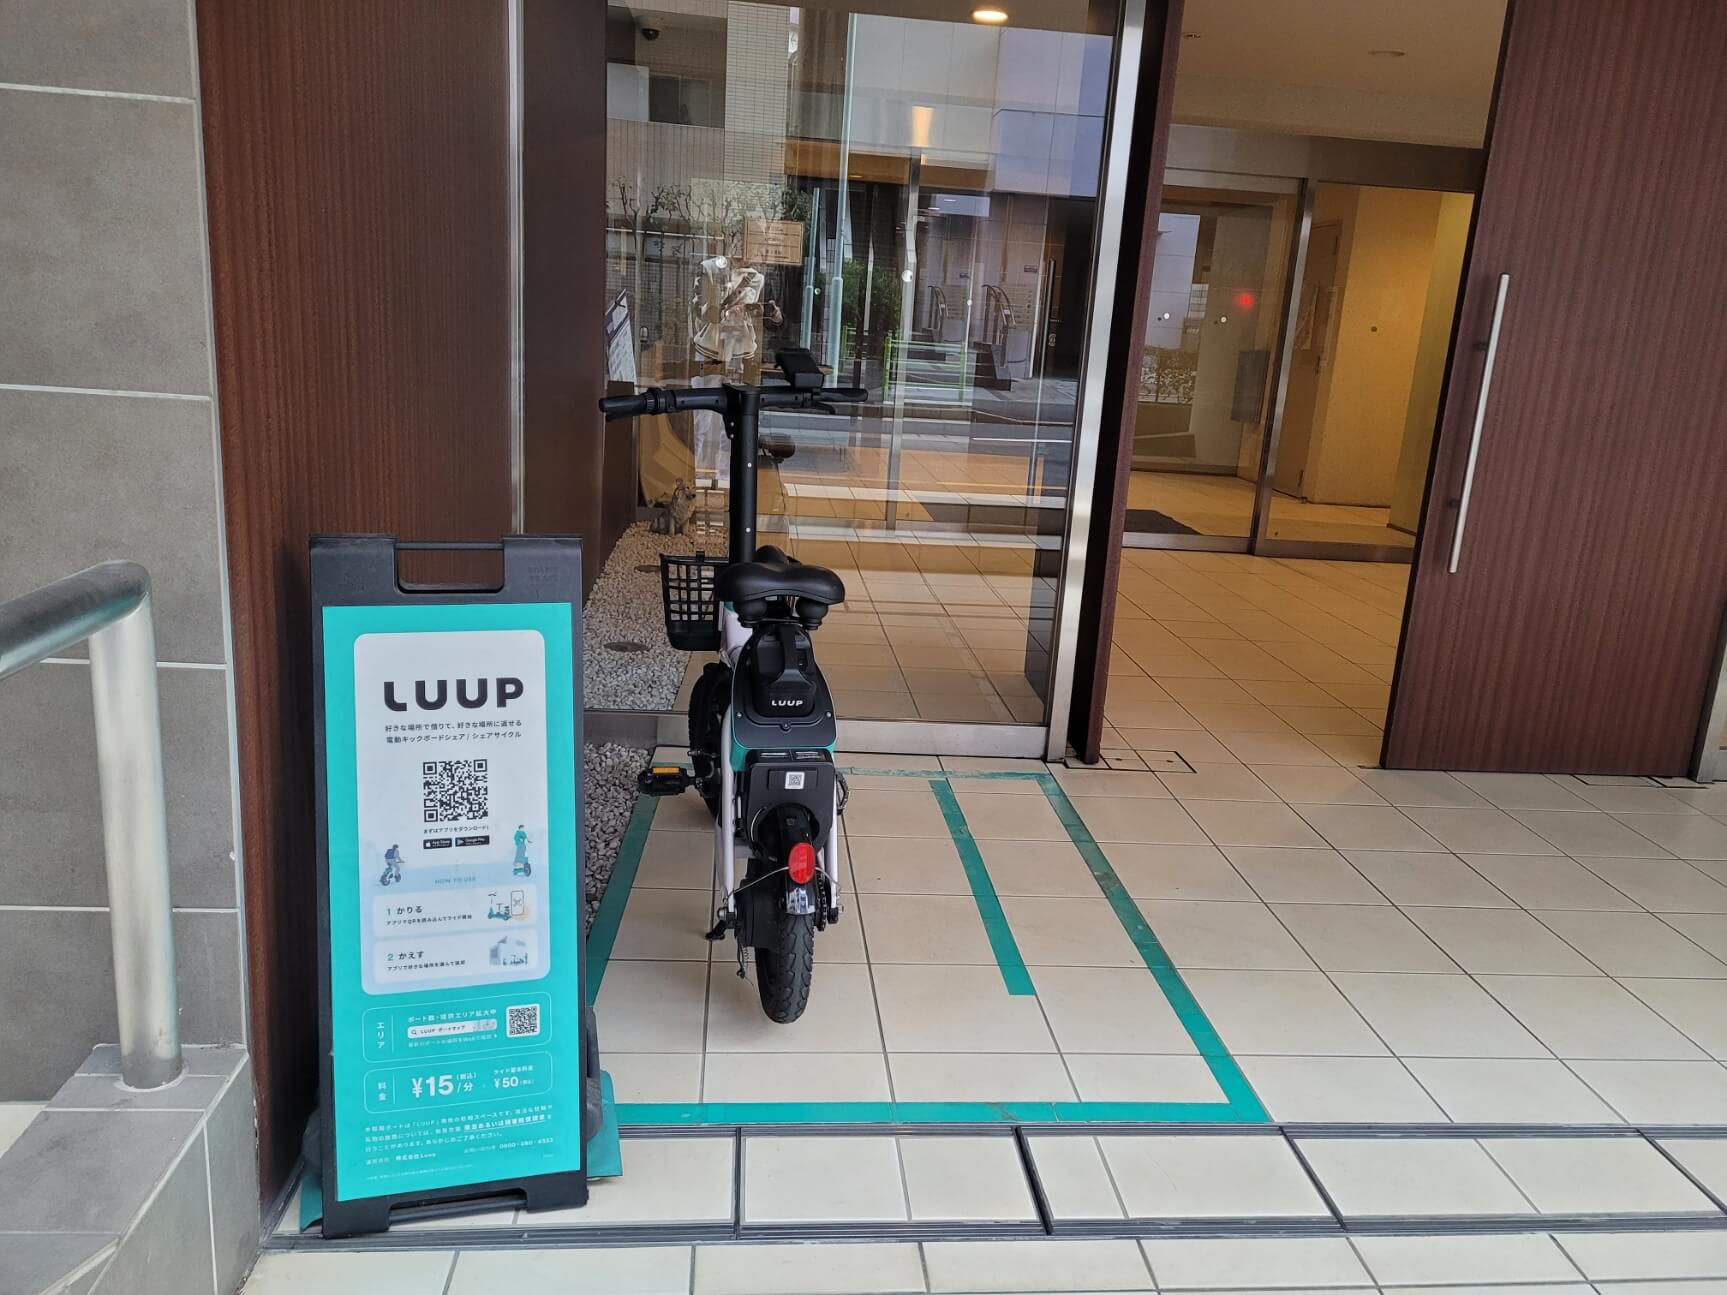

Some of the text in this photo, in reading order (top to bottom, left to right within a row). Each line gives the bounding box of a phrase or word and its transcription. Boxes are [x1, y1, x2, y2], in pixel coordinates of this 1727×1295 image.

[384, 677, 524, 712] LUUP
[397, 905, 423, 915] かりる
[387, 951, 424, 962] 2 かえす
[411, 1074, 454, 1098] ¥15
[494, 1076, 518, 1089] ¥50
